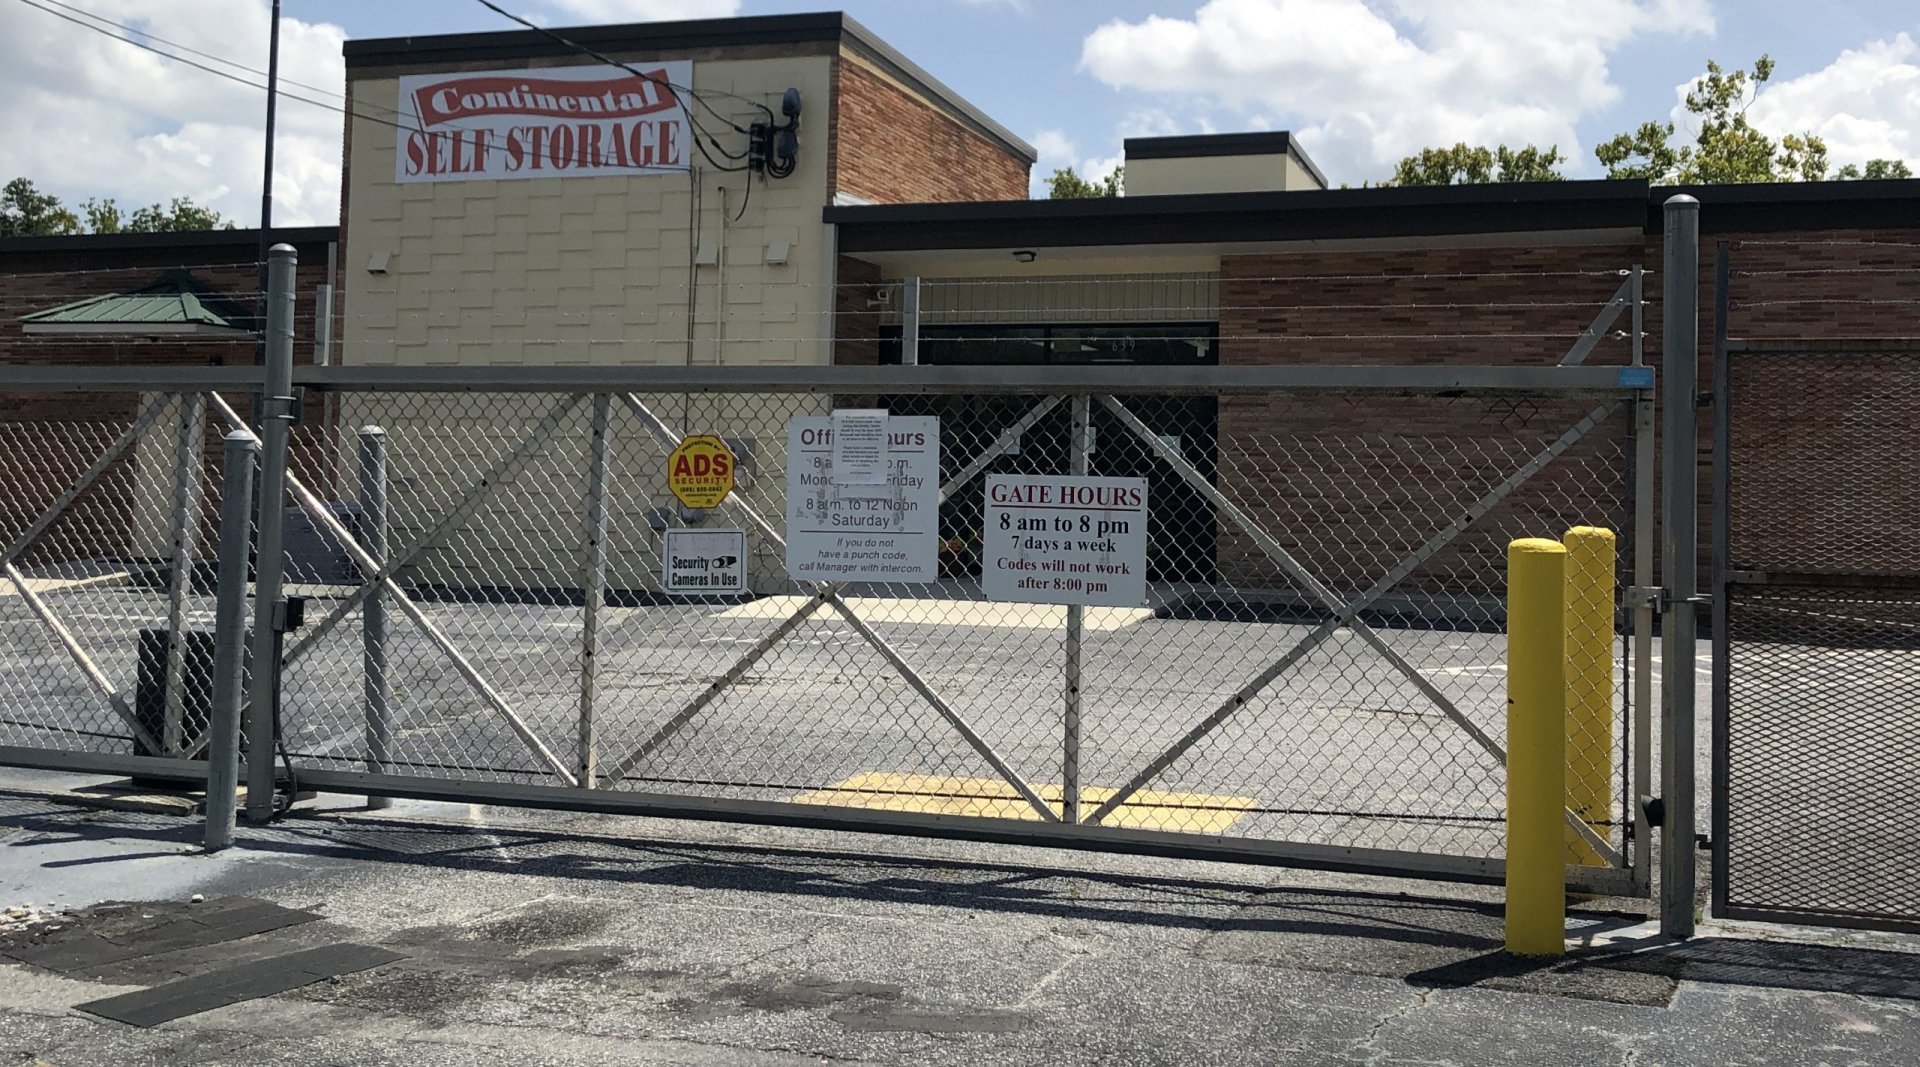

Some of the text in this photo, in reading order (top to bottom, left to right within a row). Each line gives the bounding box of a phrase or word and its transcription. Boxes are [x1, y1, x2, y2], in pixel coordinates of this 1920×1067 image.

[431, 81, 663, 114] Continental
[405, 120, 680, 176] SELF STORAGE
[673, 453, 728, 476] ADS
[813, 456, 821, 468] 8
[675, 477, 728, 485] SECURITY
[991, 483, 1142, 507] GATE HOURS
[806, 499, 918, 511] 8 a.m. to 12 Noon
[832, 513, 890, 529] Saturday
[999, 512, 1129, 538] 8 am to 8 pm
[837, 537, 894, 550] If you do not
[1011, 535, 1116, 553] 7 days a week
[672, 556, 709, 572] Security
[818, 550, 841, 559] have
[851, 551, 879, 562] punch
[882, 551, 908, 561] code,
[799, 562, 923, 573] call Manager with intercom.
[997, 557, 1130, 575] Codes will not work
[672, 572, 737, 585] Cameras In Use
[1017, 576, 1108, 594] after 8:00 pm
